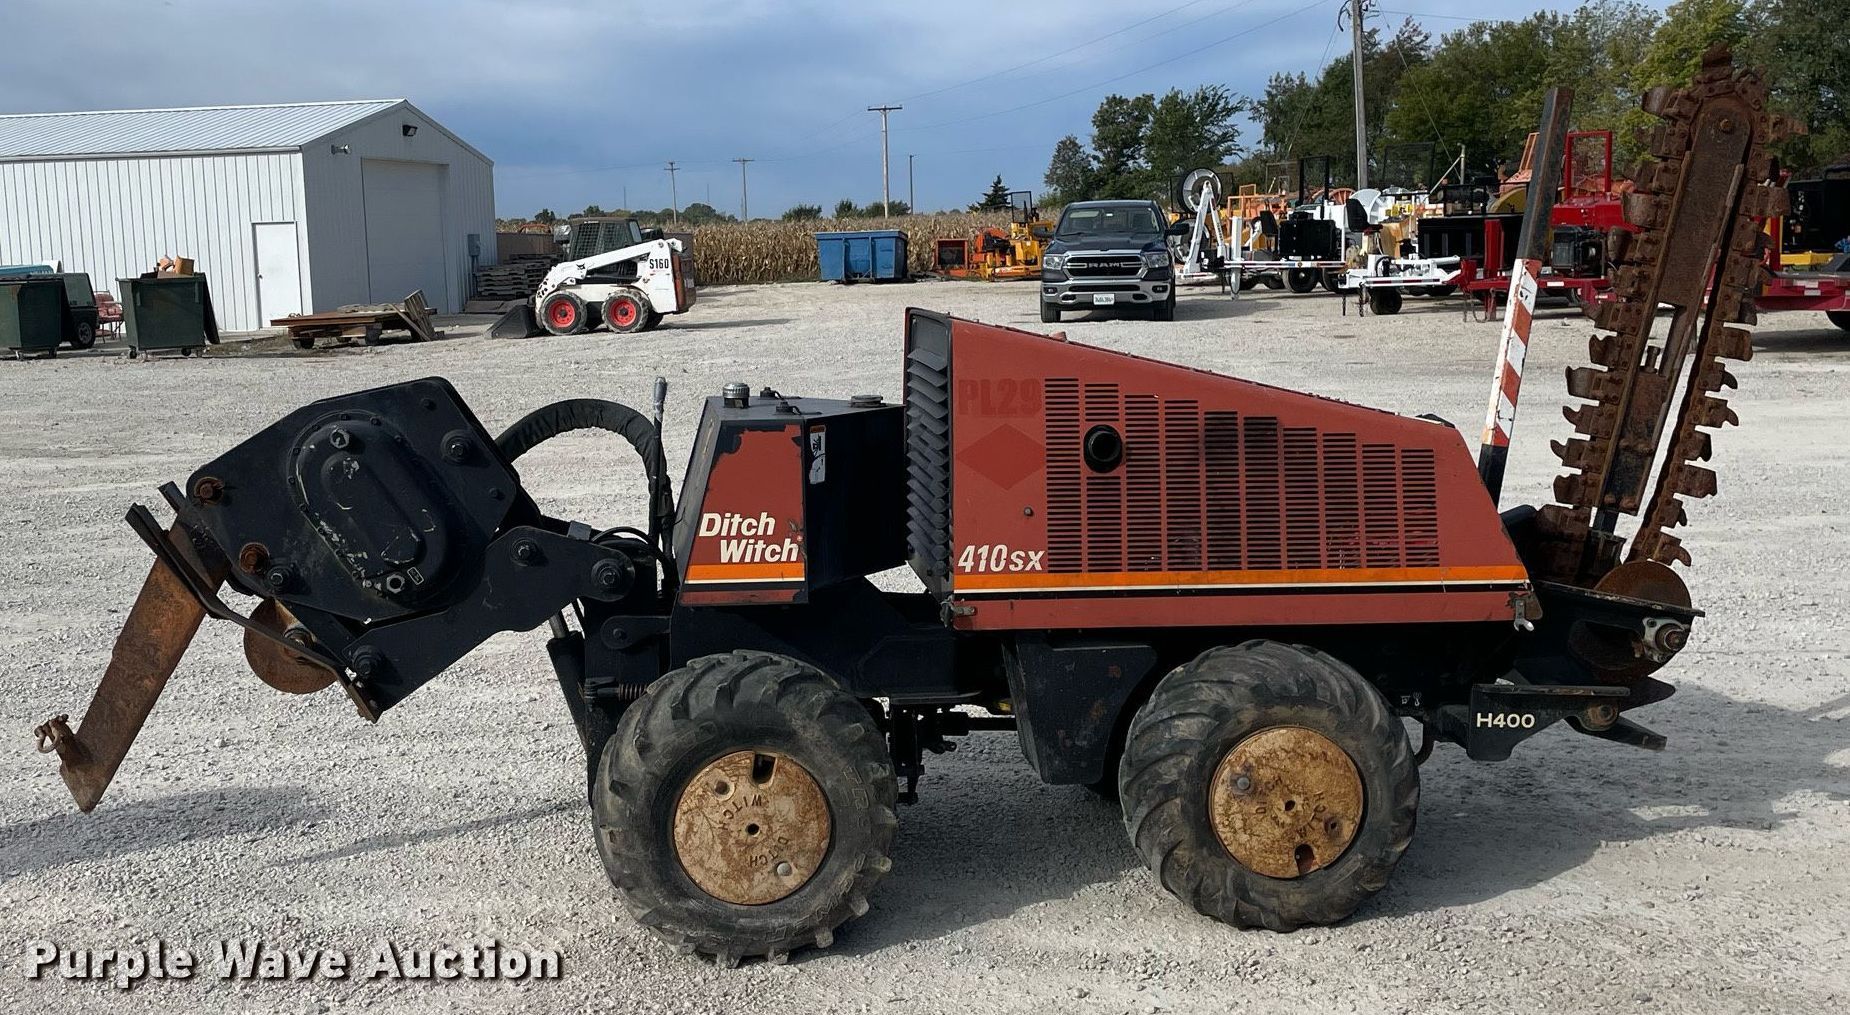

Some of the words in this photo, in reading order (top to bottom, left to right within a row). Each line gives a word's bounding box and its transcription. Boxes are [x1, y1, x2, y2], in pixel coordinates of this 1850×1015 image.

[649, 258, 669, 270] S160
[958, 378, 1042, 416] PL29
[699, 512, 776, 537] Ditch
[719, 538, 799, 563] Witch
[1476, 712, 1535, 729] H400
